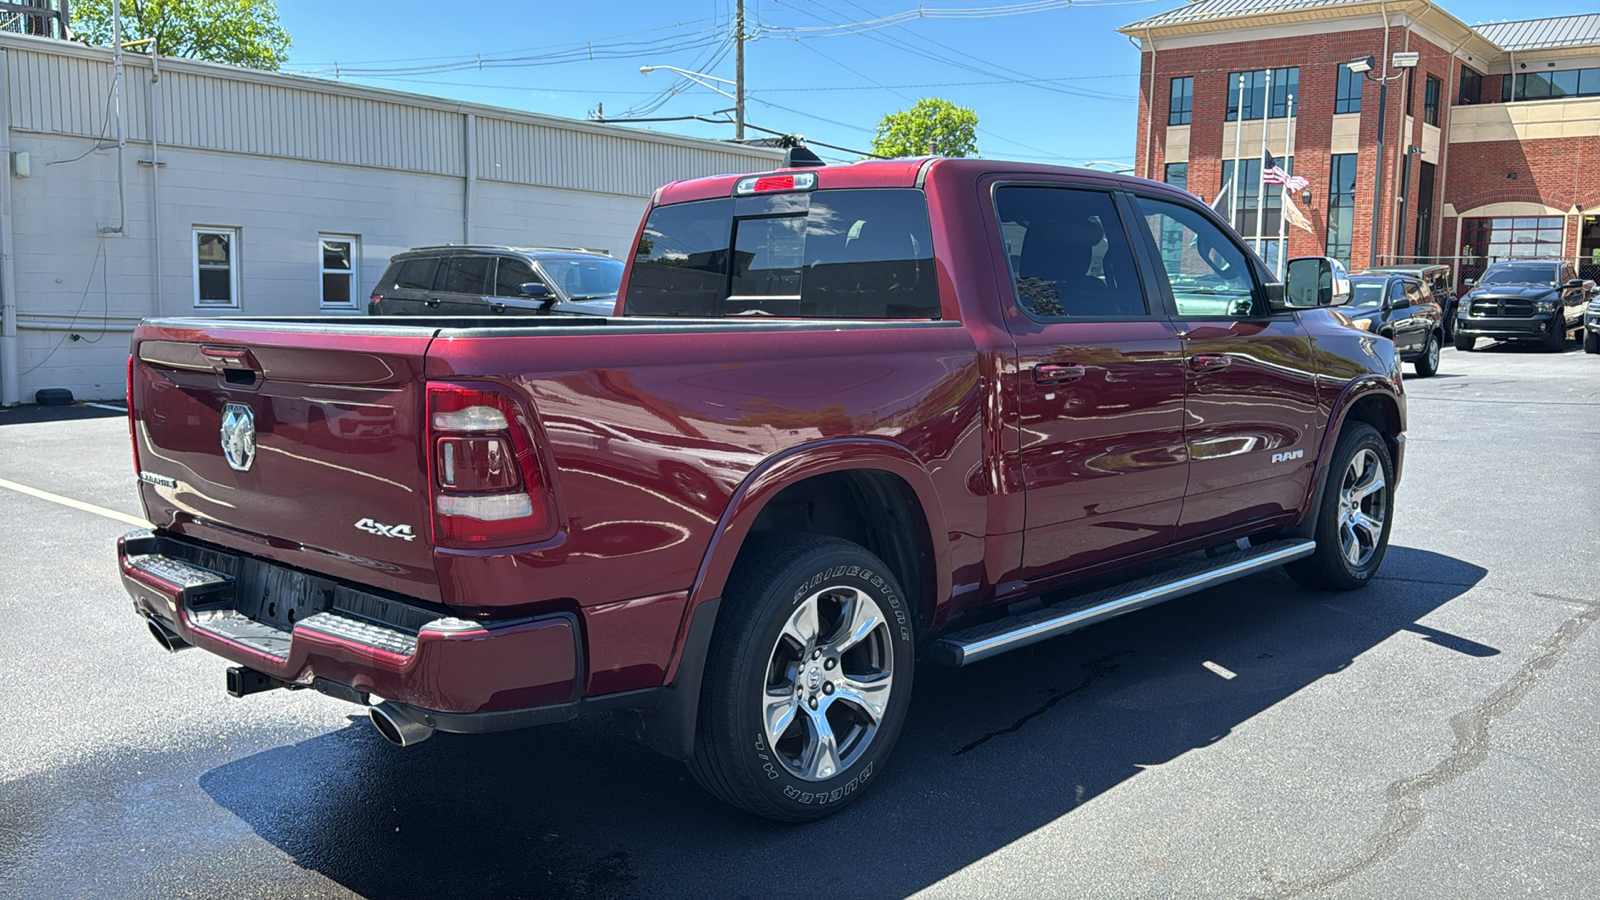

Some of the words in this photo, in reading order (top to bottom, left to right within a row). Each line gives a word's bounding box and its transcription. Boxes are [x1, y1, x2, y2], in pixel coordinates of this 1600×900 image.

[1271, 449, 1304, 463] RAM
[354, 517, 417, 541] 4x4
[793, 565, 910, 642] BRIDGESTONE
[755, 733, 779, 780] H/L
[783, 761, 873, 804] DUELER
